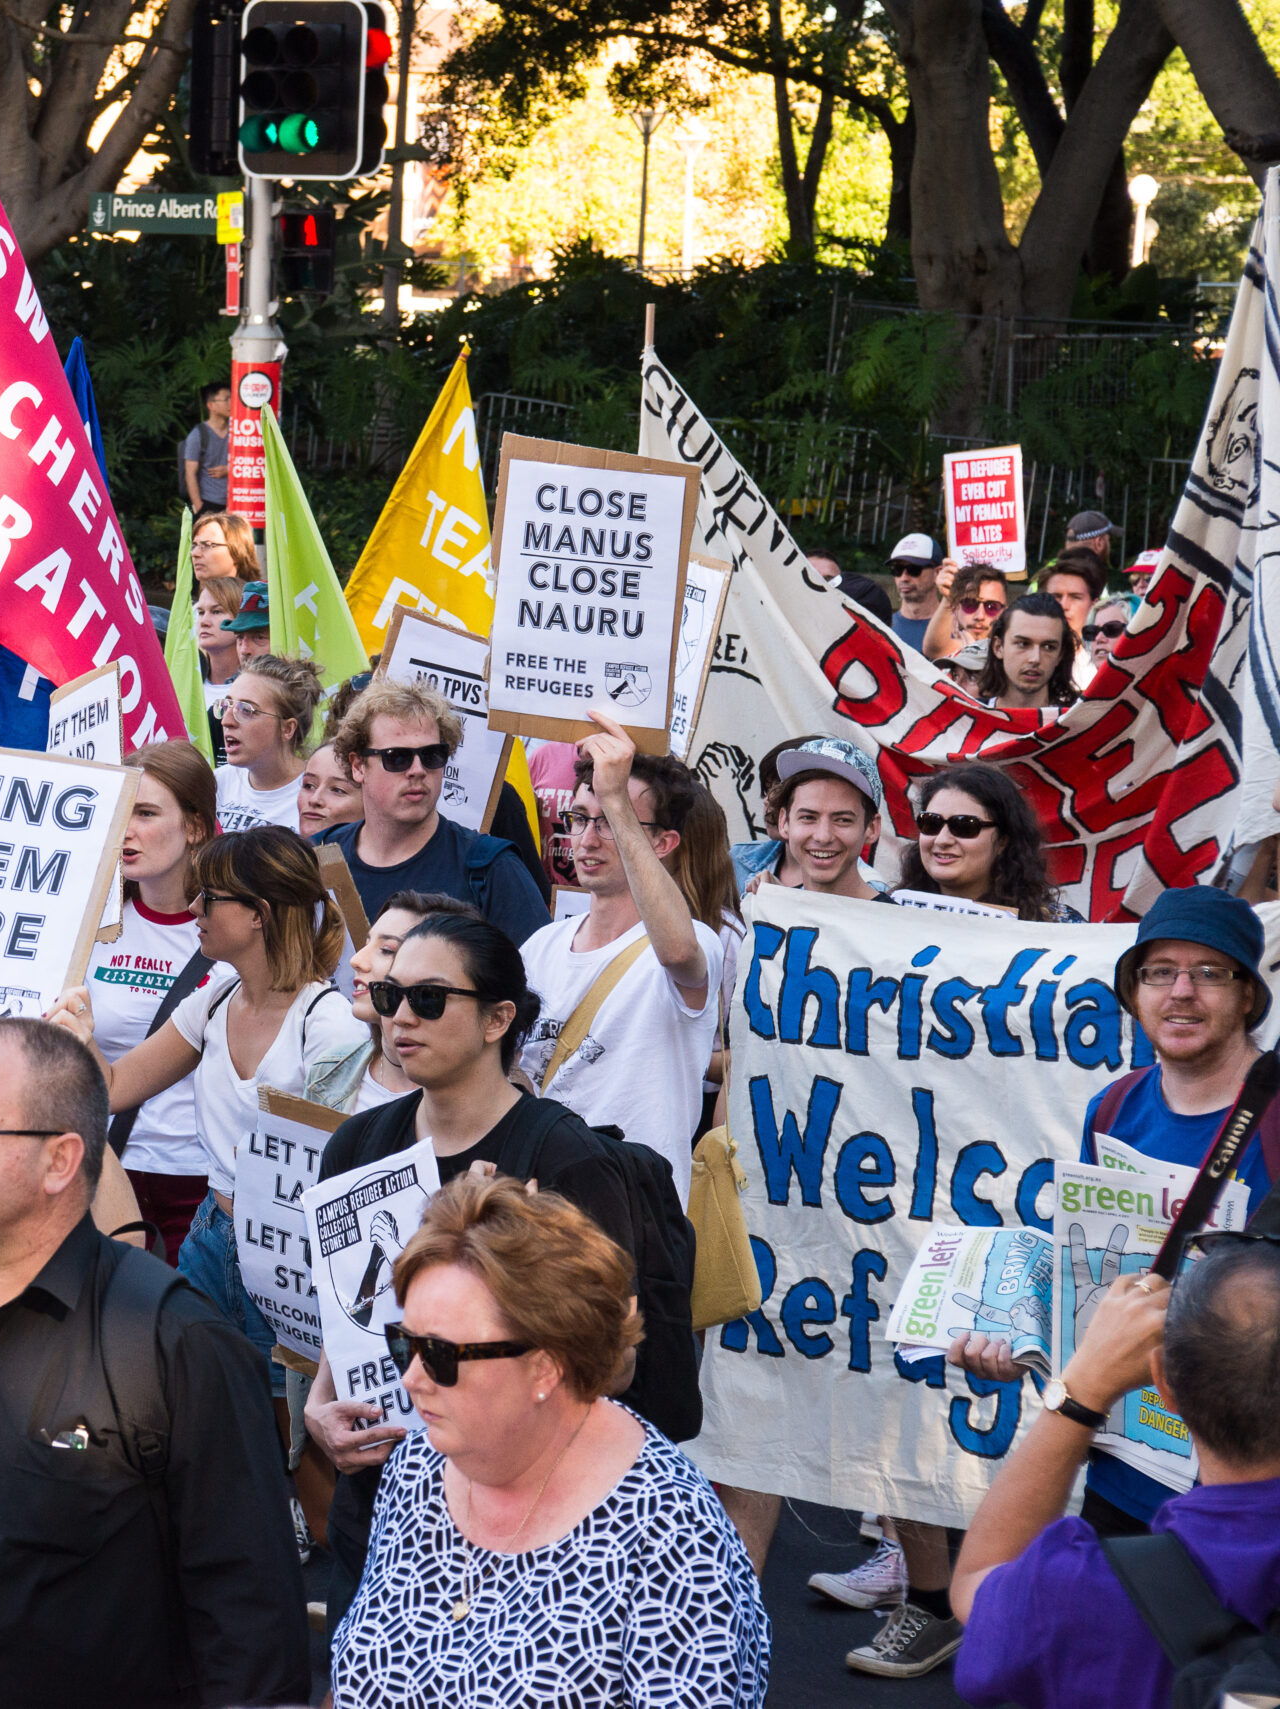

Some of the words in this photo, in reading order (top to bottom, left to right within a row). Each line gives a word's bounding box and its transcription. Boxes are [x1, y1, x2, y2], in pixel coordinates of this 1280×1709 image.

[112, 198, 155, 219] Prince
[157, 199, 198, 220] Albert
[955, 461, 969, 479] NO
[970, 458, 1011, 478] REFUGEE
[535, 482, 648, 522] CLOSE
[961, 482, 985, 501] EVER
[986, 480, 1006, 498] CUT
[955, 504, 972, 523] MY
[972, 501, 1015, 521] PENALTY
[522, 519, 654, 562] MANUS
[970, 524, 1003, 544] RATES
[961, 547, 1013, 561] Solidarity
[527, 560, 641, 600] CLOSE
[517, 598, 646, 639] NAURU
[505, 652, 549, 671] FREE
[553, 656, 587, 675] THE
[443, 677, 482, 705] TPVS
[504, 673, 594, 699] REFUGEES
[50, 717, 68, 750] LET
[71, 697, 109, 738] THEM
[110, 954, 132, 967] NOT
[134, 955, 173, 974] REALLY
[249, 1131, 297, 1166] LET
[1209, 1109, 1255, 1179] Canon
[317, 1197, 349, 1226] CAMPUS
[349, 1181, 383, 1211] REFUGEE
[384, 1167, 415, 1195] ACTION
[1061, 1181, 1154, 1217] green
[1162, 1187, 1220, 1228] let
[1223, 1200, 1235, 1232] Weekly
[245, 1217, 292, 1256] LET
[319, 1213, 356, 1241] COLLECTIVE
[321, 1235, 347, 1255] SYDNEY
[347, 1229, 359, 1244] UNI
[920, 1237, 963, 1269] left
[996, 1230, 1040, 1296] BRING
[1024, 1246, 1053, 1297] THEM
[905, 1270, 948, 1339] green
[1139, 1406, 1190, 1443] DANGER
